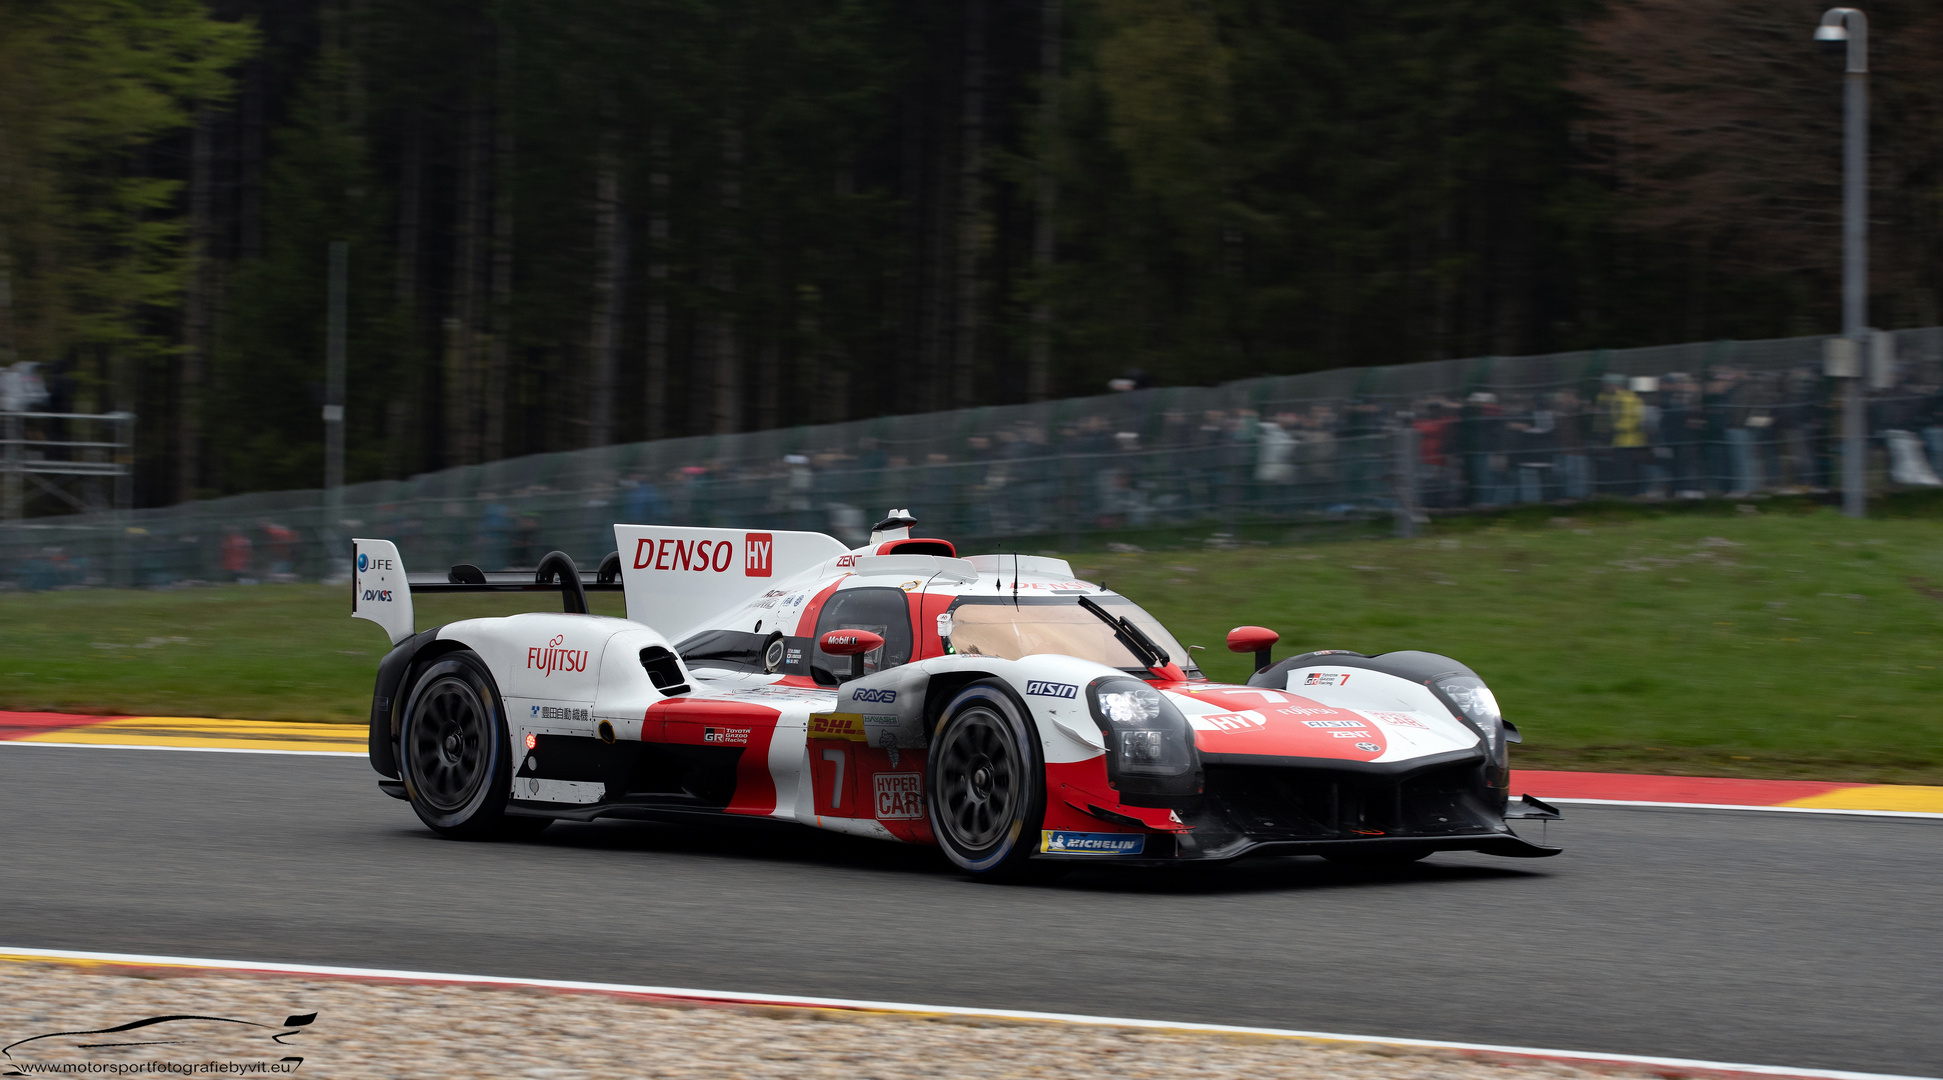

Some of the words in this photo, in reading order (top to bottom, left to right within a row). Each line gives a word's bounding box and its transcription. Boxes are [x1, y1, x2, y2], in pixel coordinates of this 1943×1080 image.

[633, 538, 733, 573] DENSO
[746, 541, 771, 569] HY
[370, 559, 392, 570] JFE
[1010, 581, 1093, 590] DENSO
[362, 589, 392, 602] ADVICS
[828, 635, 850, 645] Mobil
[527, 646, 588, 678] FUJITSU
[1340, 674, 1351, 686] 7
[854, 688, 896, 703] RAYS
[1027, 682, 1077, 698] AISIN
[1222, 689, 1290, 704] 7
[864, 715, 897, 723] HAYASHI
[1276, 707, 1339, 717] FUJITSU
[814, 717, 856, 735] DHL
[1208, 715, 1252, 731] HY
[705, 733, 724, 742] GR
[1326, 730, 1372, 739] ZENT
[821, 748, 846, 809] 7
[877, 777, 918, 793] HYPER
[879, 791, 920, 815] CAR
[1066, 838, 1136, 850] MICHELIN
